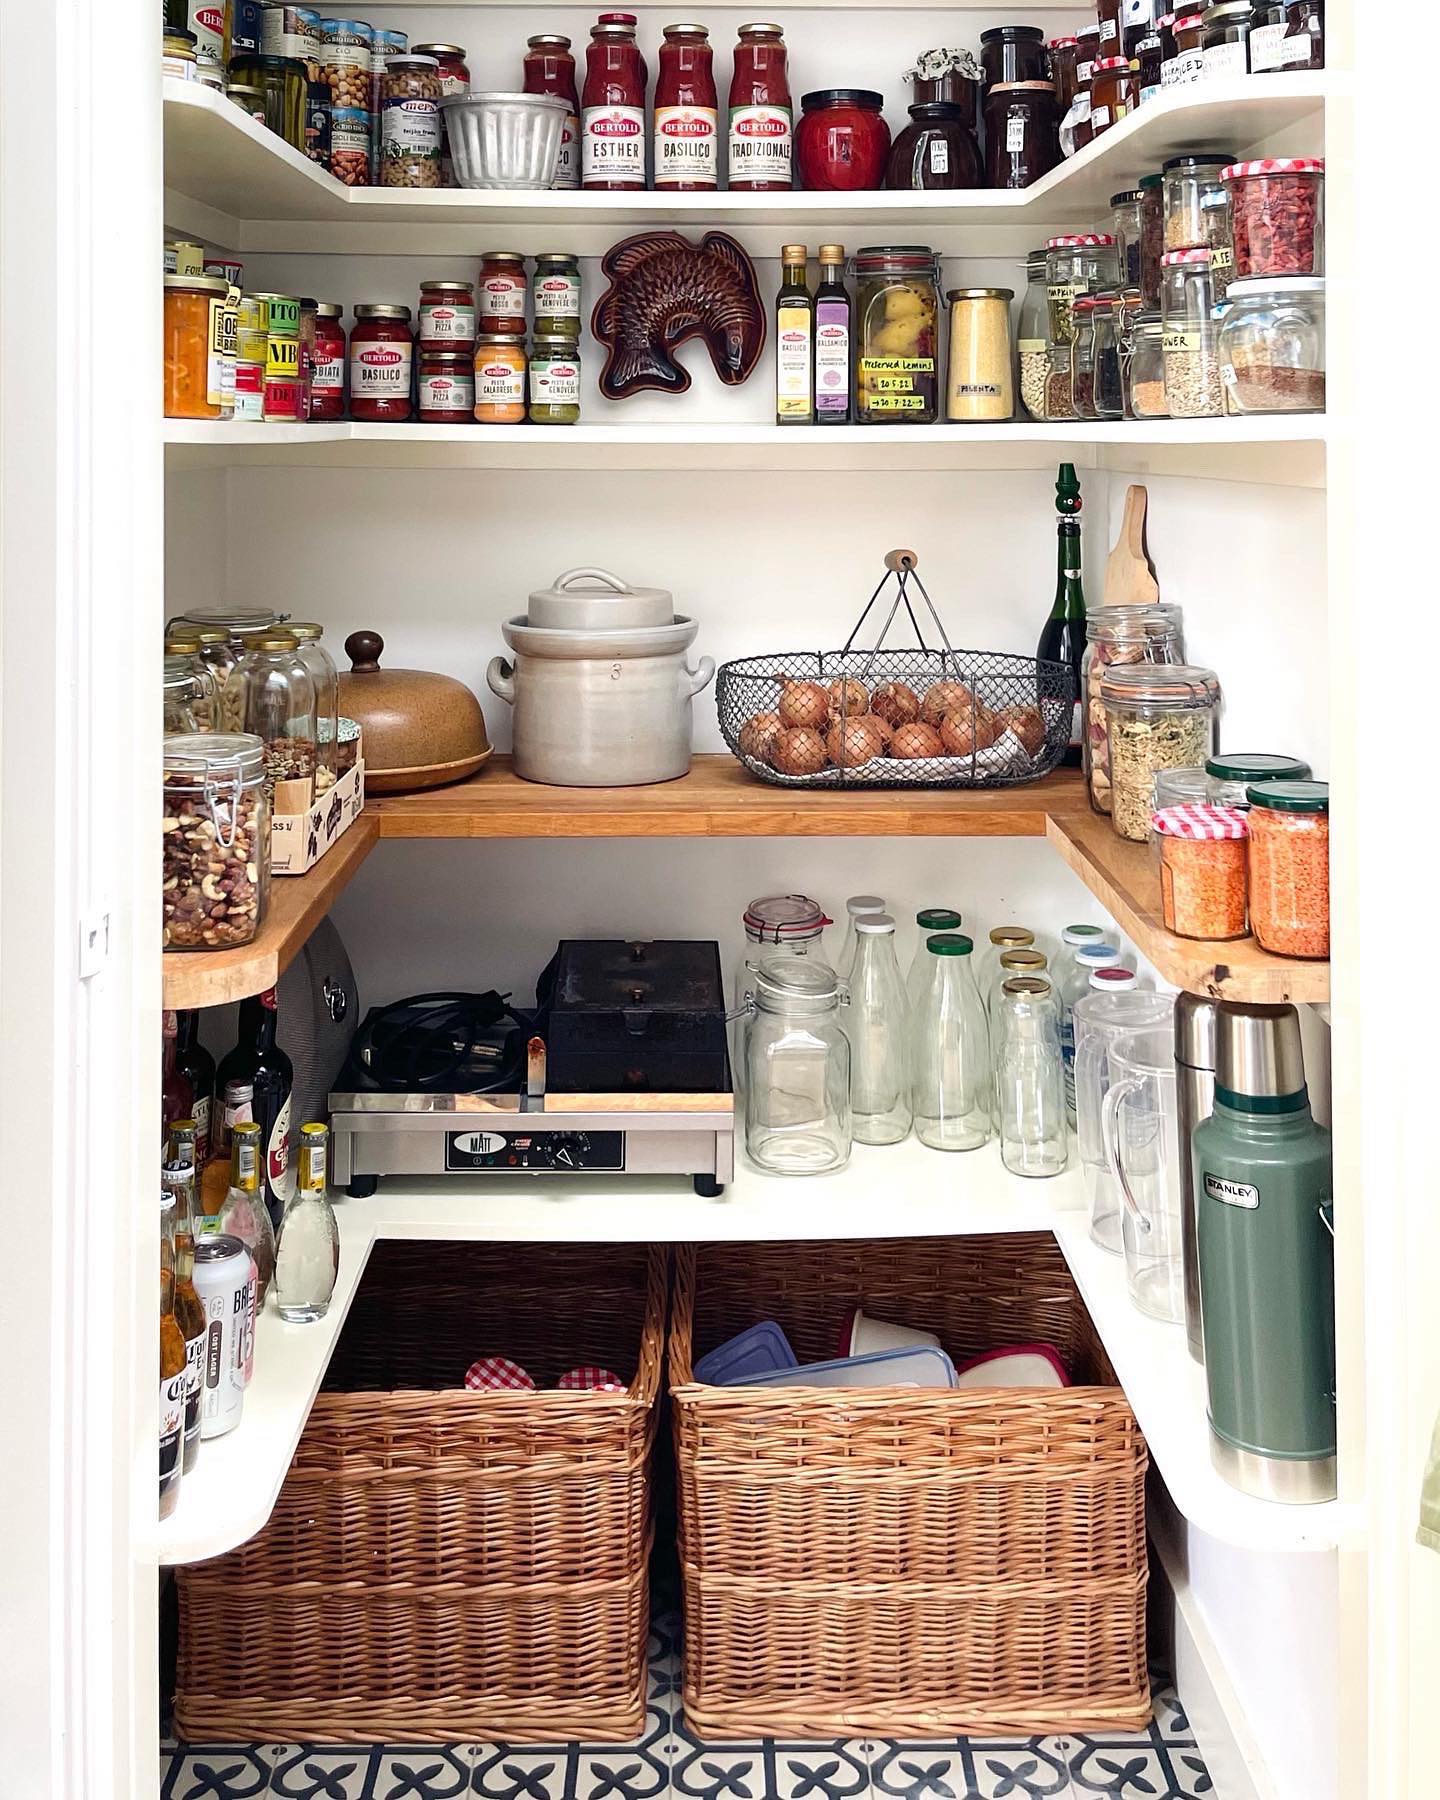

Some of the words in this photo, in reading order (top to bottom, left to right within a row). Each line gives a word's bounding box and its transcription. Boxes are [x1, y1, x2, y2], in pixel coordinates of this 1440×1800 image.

[594, 122, 638, 133] BERTOLLI
[665, 122, 709, 133] BERTOLLI
[739, 122, 784, 133] BERTOLLI
[593, 142, 639, 157] ESTHER
[664, 142, 710, 158] BASILICO
[732, 142, 790, 159] TRADIZIONALE
[434, 323, 451, 331] PIZZA
[817, 339, 847, 347] BALSAMICO
[363, 354, 400, 362] BERTOLLI
[864, 360, 900, 369] Preserved
[362, 368, 401, 381] BASILICO
[483, 386, 513, 394] CALABRESE
[432, 393, 449, 401] PIZZA
[609, 663, 624, 681] 3
[1207, 1178, 1252, 1197] STANLEY
